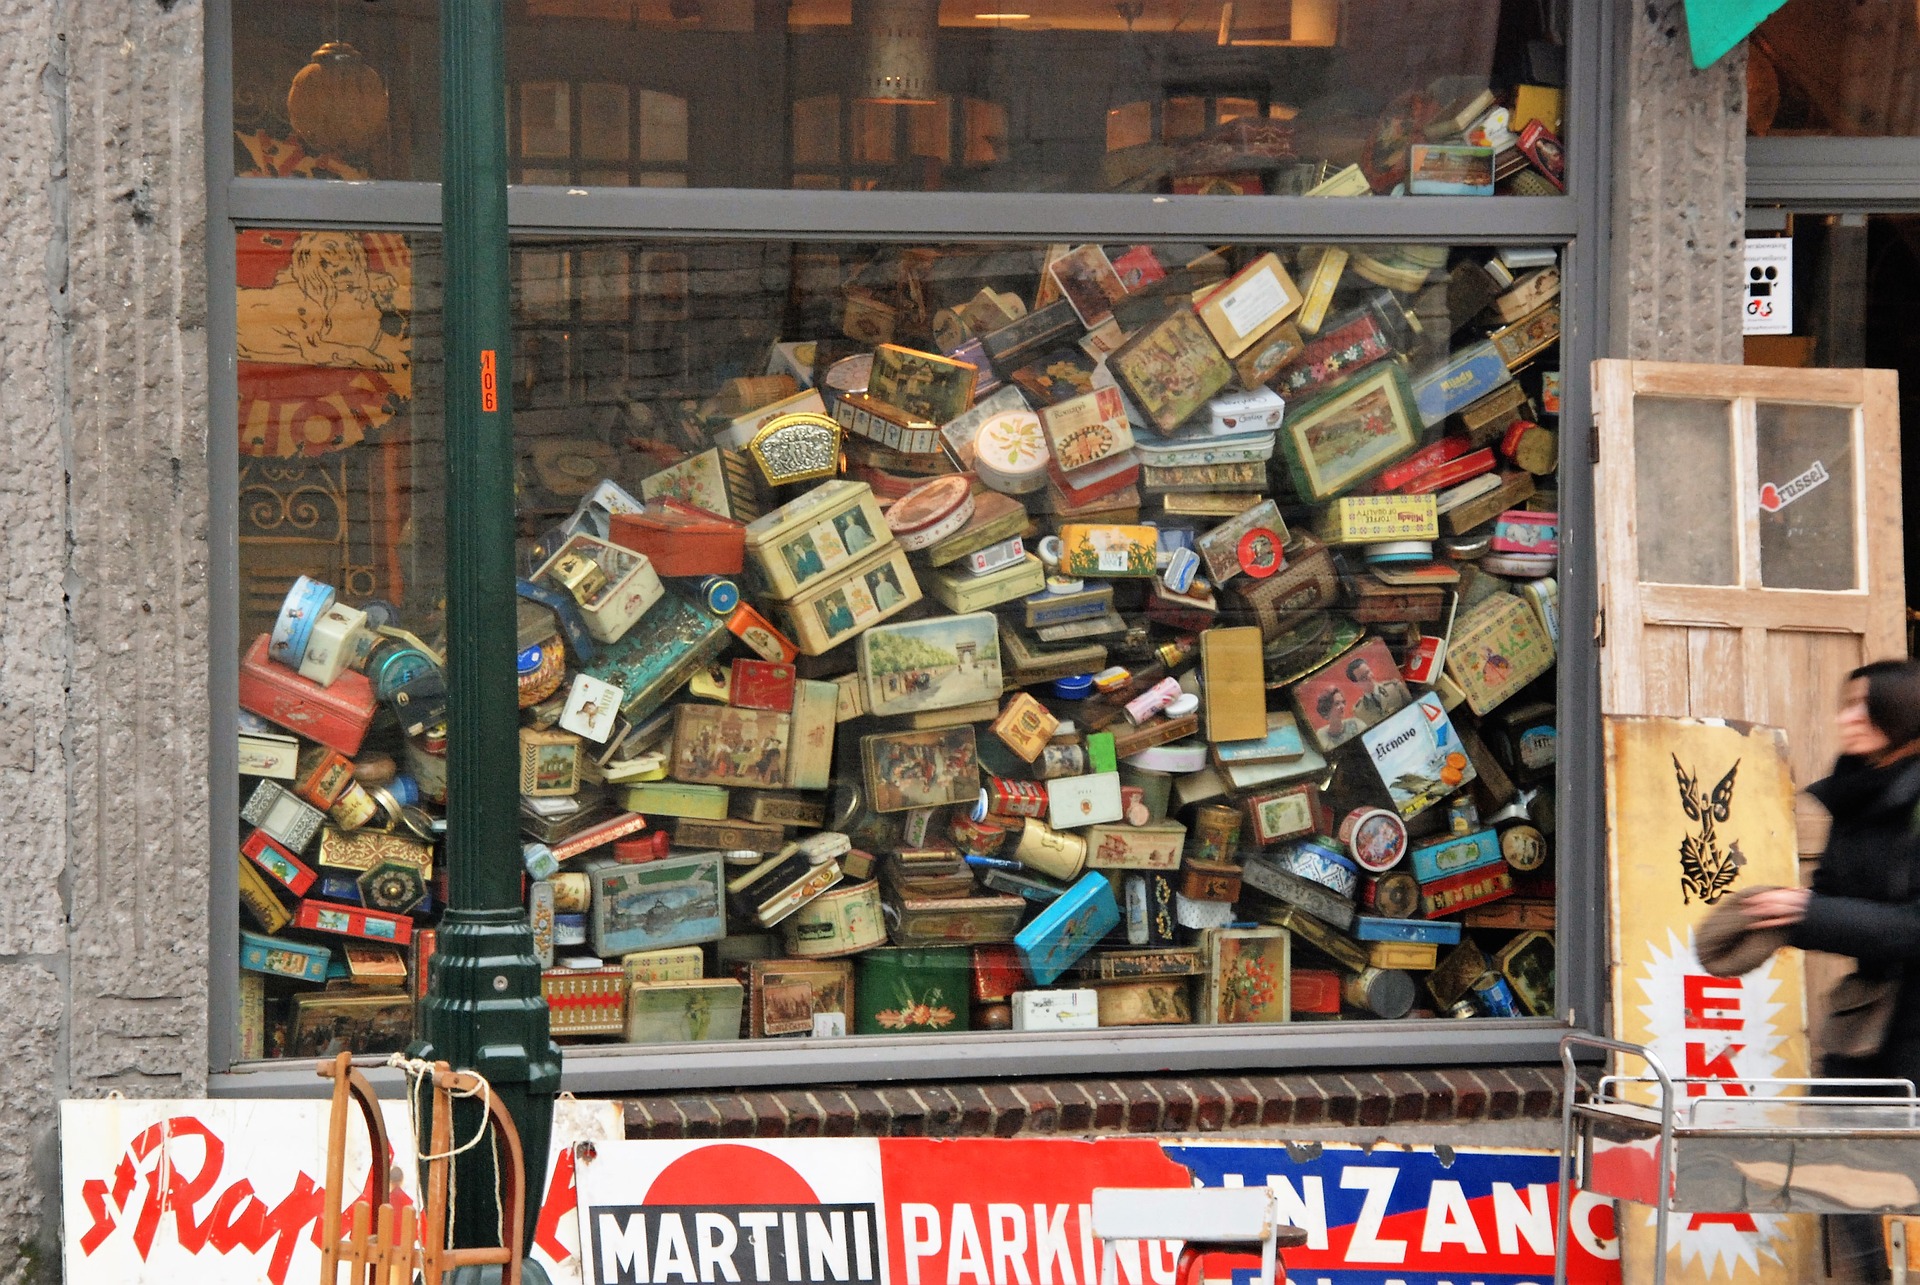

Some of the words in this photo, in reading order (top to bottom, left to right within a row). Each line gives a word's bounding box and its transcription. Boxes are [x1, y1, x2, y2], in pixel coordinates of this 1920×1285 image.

[484, 354, 493, 409] 106
[598, 1210, 873, 1285] MARTINI
[1193, 1165, 1619, 1263] NZANO
